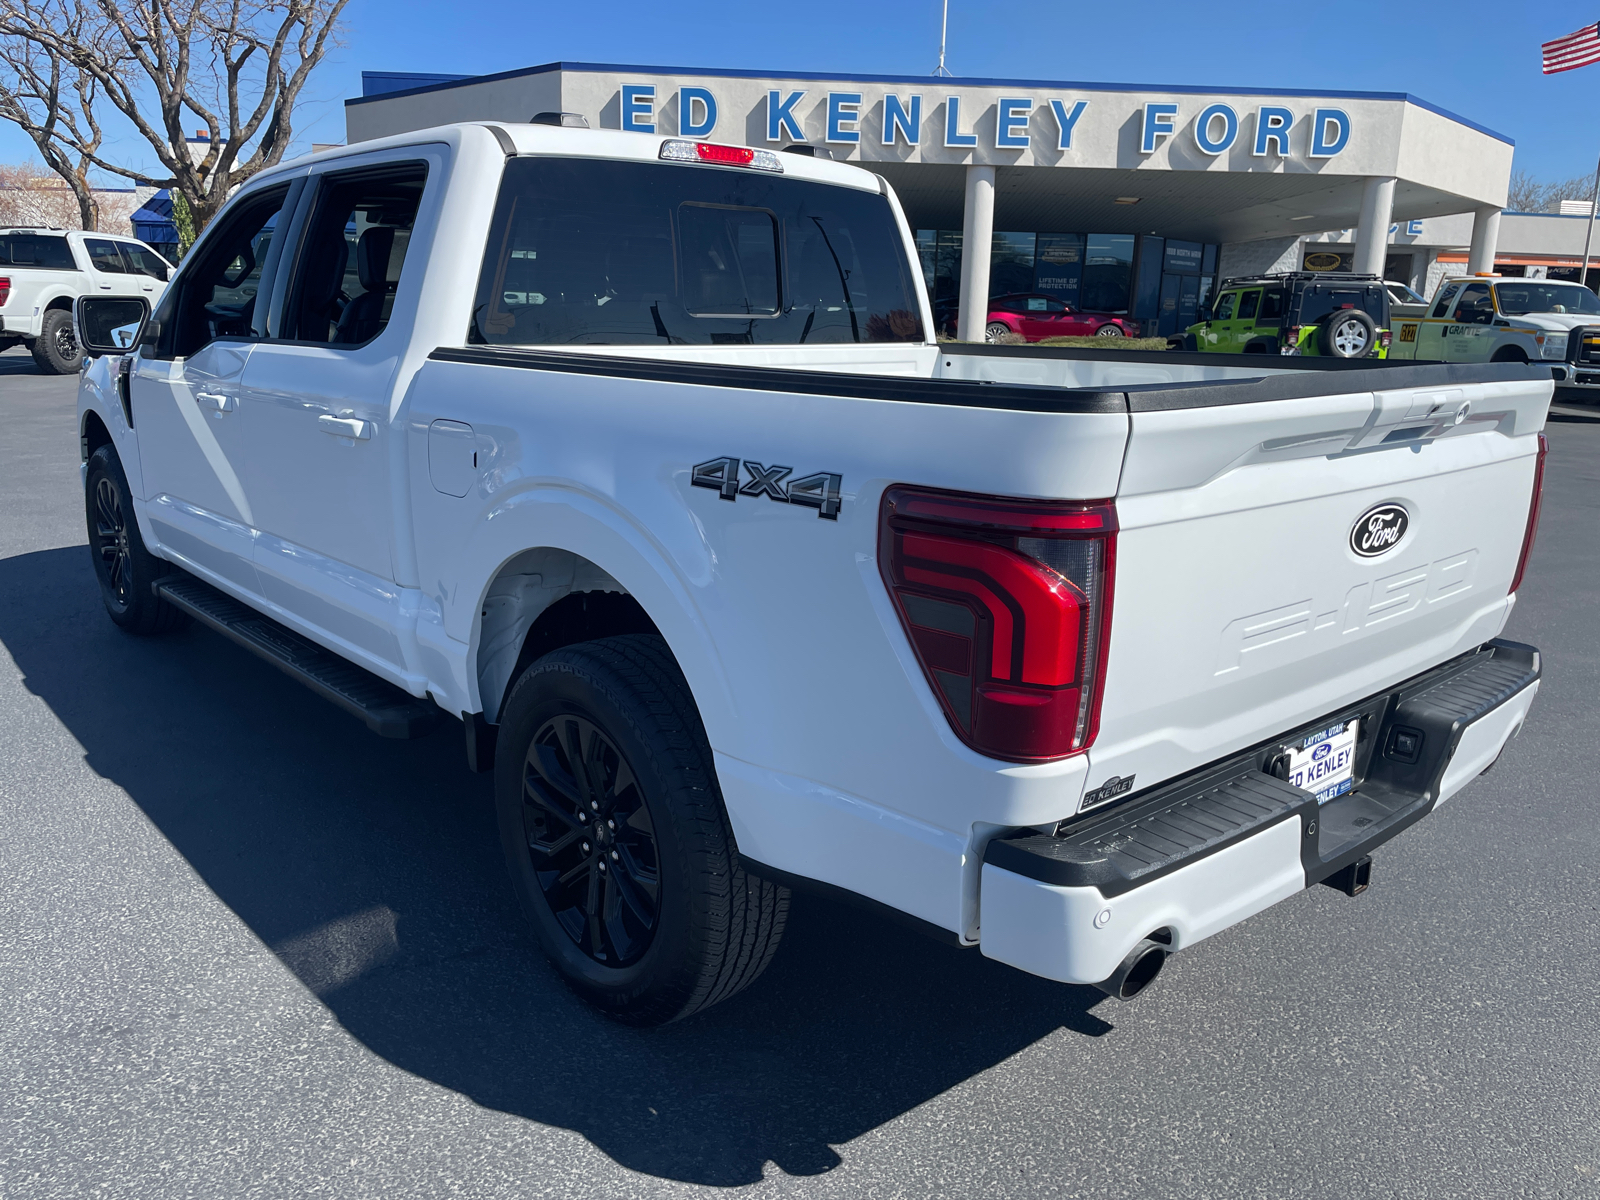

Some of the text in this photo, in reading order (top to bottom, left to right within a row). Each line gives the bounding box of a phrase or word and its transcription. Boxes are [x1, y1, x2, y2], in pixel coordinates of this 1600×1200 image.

[620, 84, 1351, 160] ED KENLEY FORD
[1361, 512, 1402, 549] Ford
[1214, 547, 1480, 677] F-150
[1328, 722, 1344, 737] UTAH
[1307, 747, 1352, 783] KENLEY
[1084, 794, 1095, 805] ED
[1098, 780, 1134, 800] KENLEY
[1315, 785, 1339, 804] ENLEY
